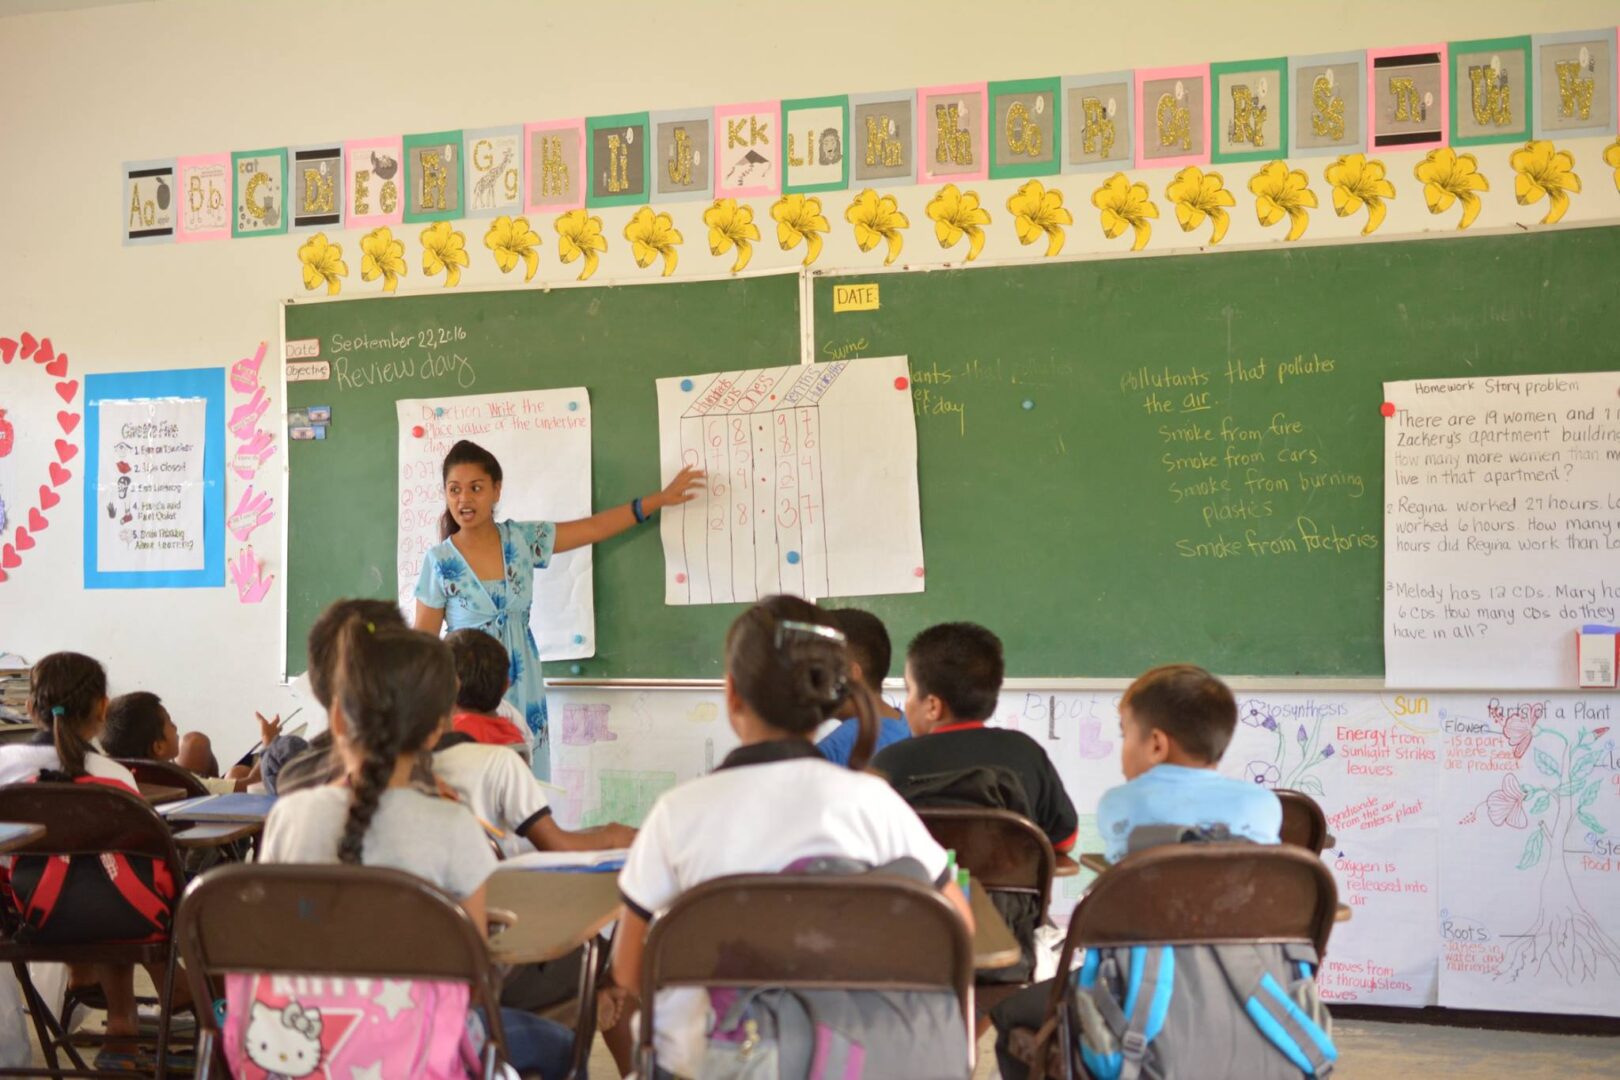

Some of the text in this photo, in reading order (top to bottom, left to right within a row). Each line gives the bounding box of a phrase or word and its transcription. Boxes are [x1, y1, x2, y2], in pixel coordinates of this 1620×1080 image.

[837, 288, 873, 304] DATE
[331, 331, 414, 353] September
[334, 353, 475, 392] Review day
[1225, 360, 1267, 383] that
[1415, 378, 1579, 396] Homework Story problem
[523, 400, 544, 413] the
[1144, 393, 1174, 414] the
[1159, 412, 1302, 442] Smoke from fire
[1396, 409, 1442, 428] There
[1448, 417, 1475, 426] are
[1503, 412, 1556, 425] women
[1566, 407, 1594, 421] and
[1469, 427, 1550, 446] apartment
[1162, 446, 1317, 472] Smoke from cars
[1425, 453, 1459, 469] many
[1467, 452, 1500, 464] more
[1510, 450, 1560, 464] women
[1169, 468, 1364, 503] Smoke from burning
[1395, 470, 1418, 486] live
[1427, 471, 1437, 484] in
[1441, 471, 1475, 485] that
[1203, 499, 1273, 527] plastics
[1398, 496, 1447, 519] Regina
[1456, 497, 1516, 513] worked
[1396, 519, 1448, 534] worked
[1458, 519, 1469, 532] 6
[1528, 517, 1556, 531] How
[1566, 518, 1612, 536] many
[1175, 516, 1378, 559] Smoke from factories
[1396, 536, 1430, 552] hours
[1438, 536, 1459, 551] did
[1467, 535, 1509, 556] Regina
[1518, 537, 1560, 550] work
[1568, 533, 1599, 550] than
[1396, 583, 1443, 603] Melody
[1450, 584, 1481, 601] has
[1556, 584, 1596, 603] Mary
[1445, 606, 1471, 619] How
[1477, 606, 1515, 625] many
[1559, 604, 1577, 619] do
[1581, 602, 1615, 621] they
[1393, 623, 1426, 639] have
[1433, 625, 1446, 639] in
[1394, 695, 1429, 716] Sun
[1555, 708, 1565, 719] a
[1574, 702, 1612, 720] Plant
[1445, 717, 1486, 733] Flower
[1337, 726, 1387, 747] Energy
[1390, 726, 1425, 744] from
[1347, 760, 1393, 776] leaves
[1396, 799, 1423, 823] plant
[1335, 859, 1396, 879] Oxygen is
[1347, 878, 1401, 893] released
[1443, 921, 1488, 940] Roots
[1329, 959, 1393, 977] moves from
